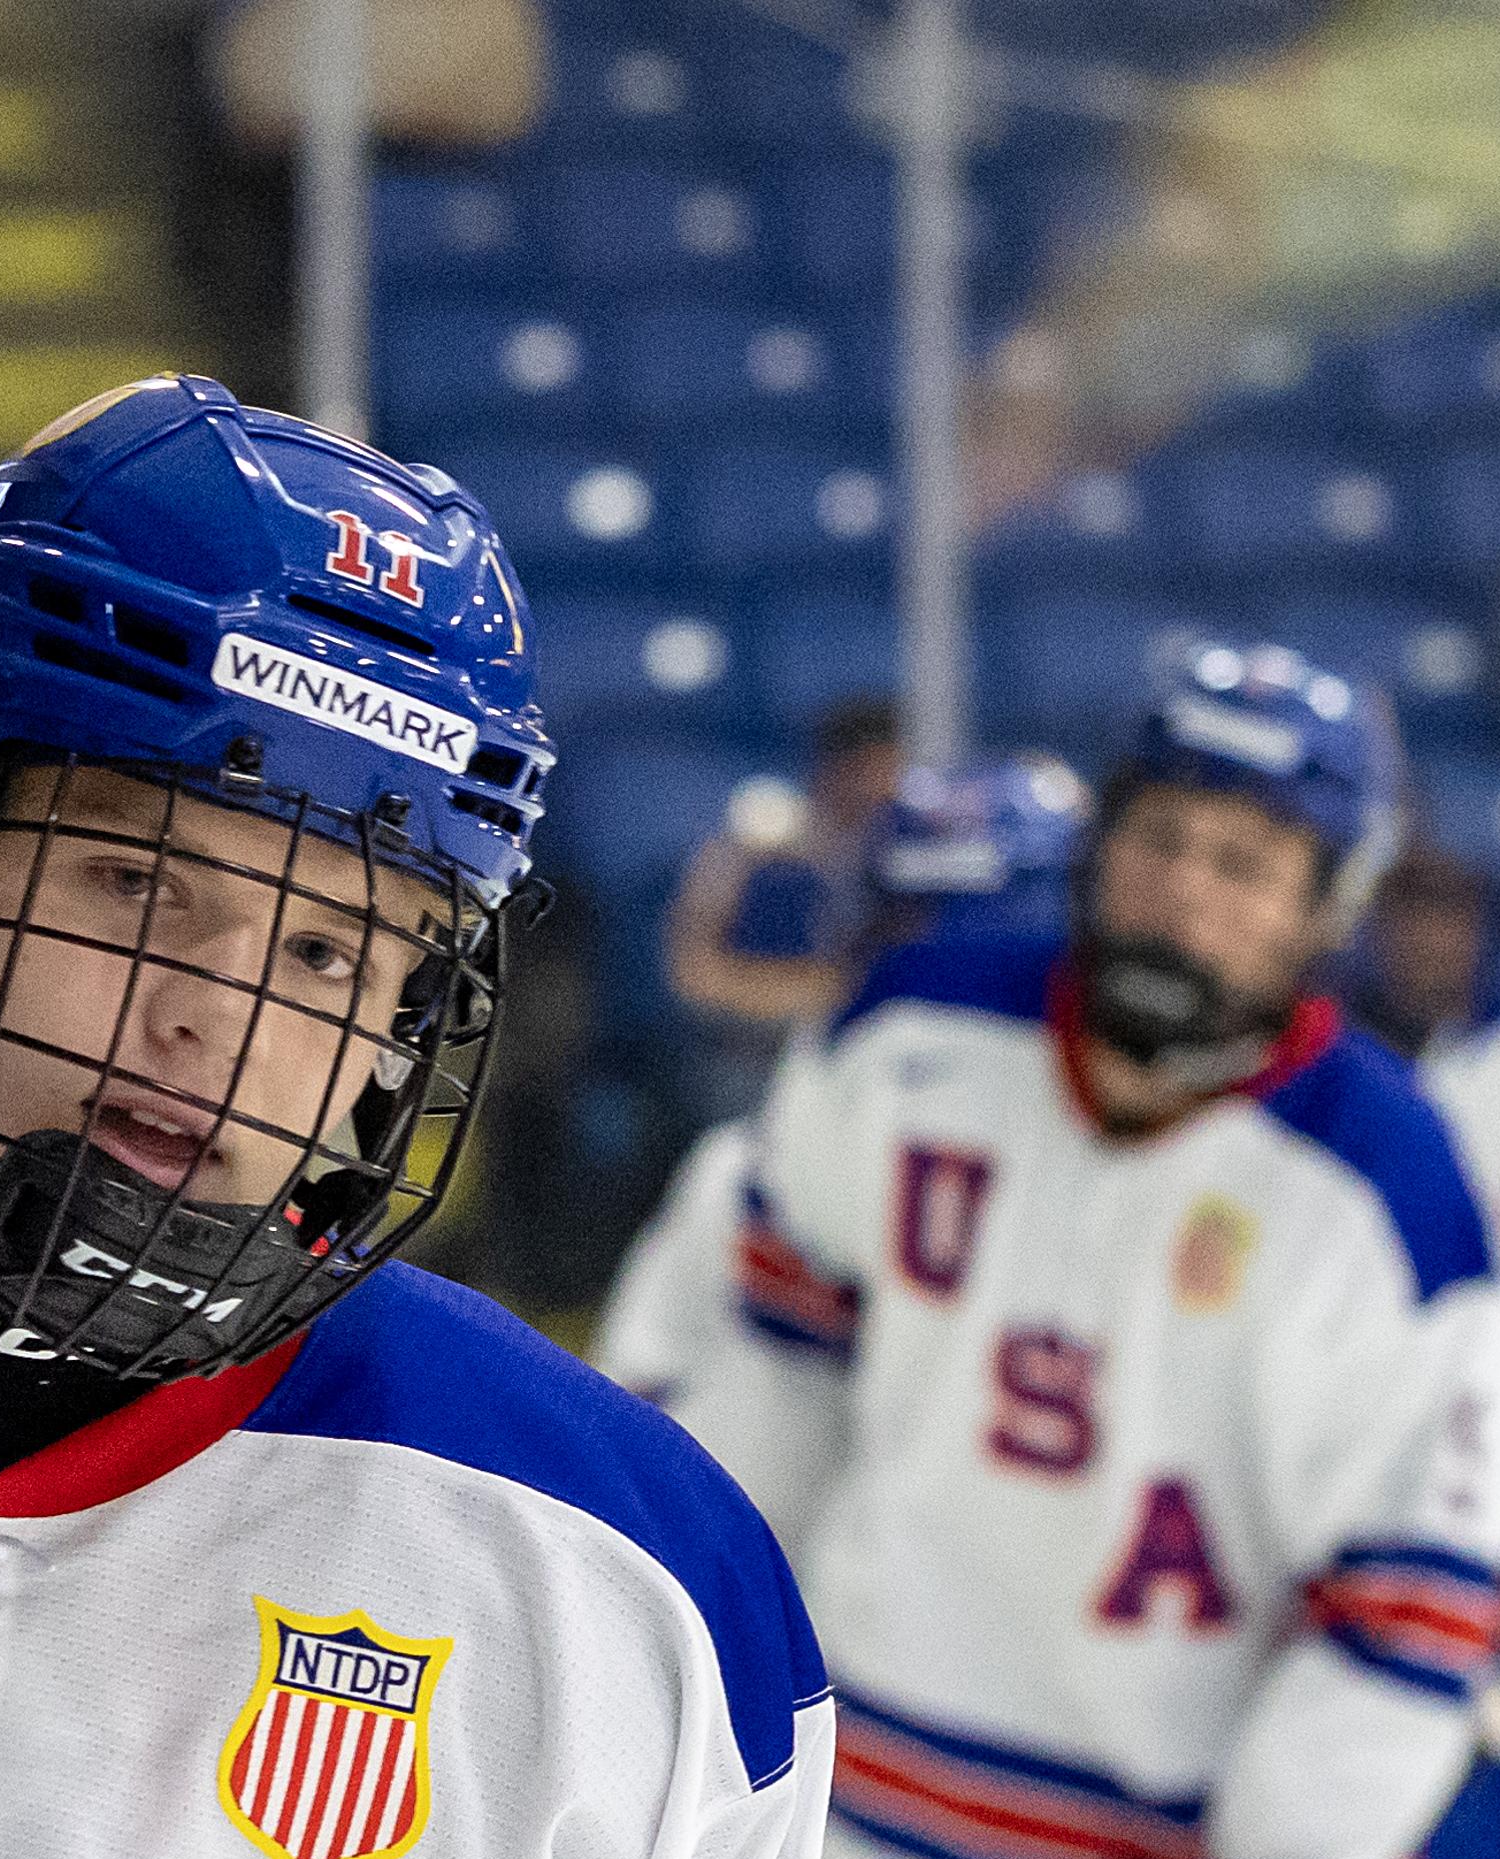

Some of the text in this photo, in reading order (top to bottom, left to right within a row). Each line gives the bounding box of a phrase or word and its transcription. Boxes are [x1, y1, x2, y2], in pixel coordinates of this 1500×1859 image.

[325, 510, 424, 609] 11
[229, 643, 468, 763] WINMARK
[289, 1637, 411, 1702] NTDP
